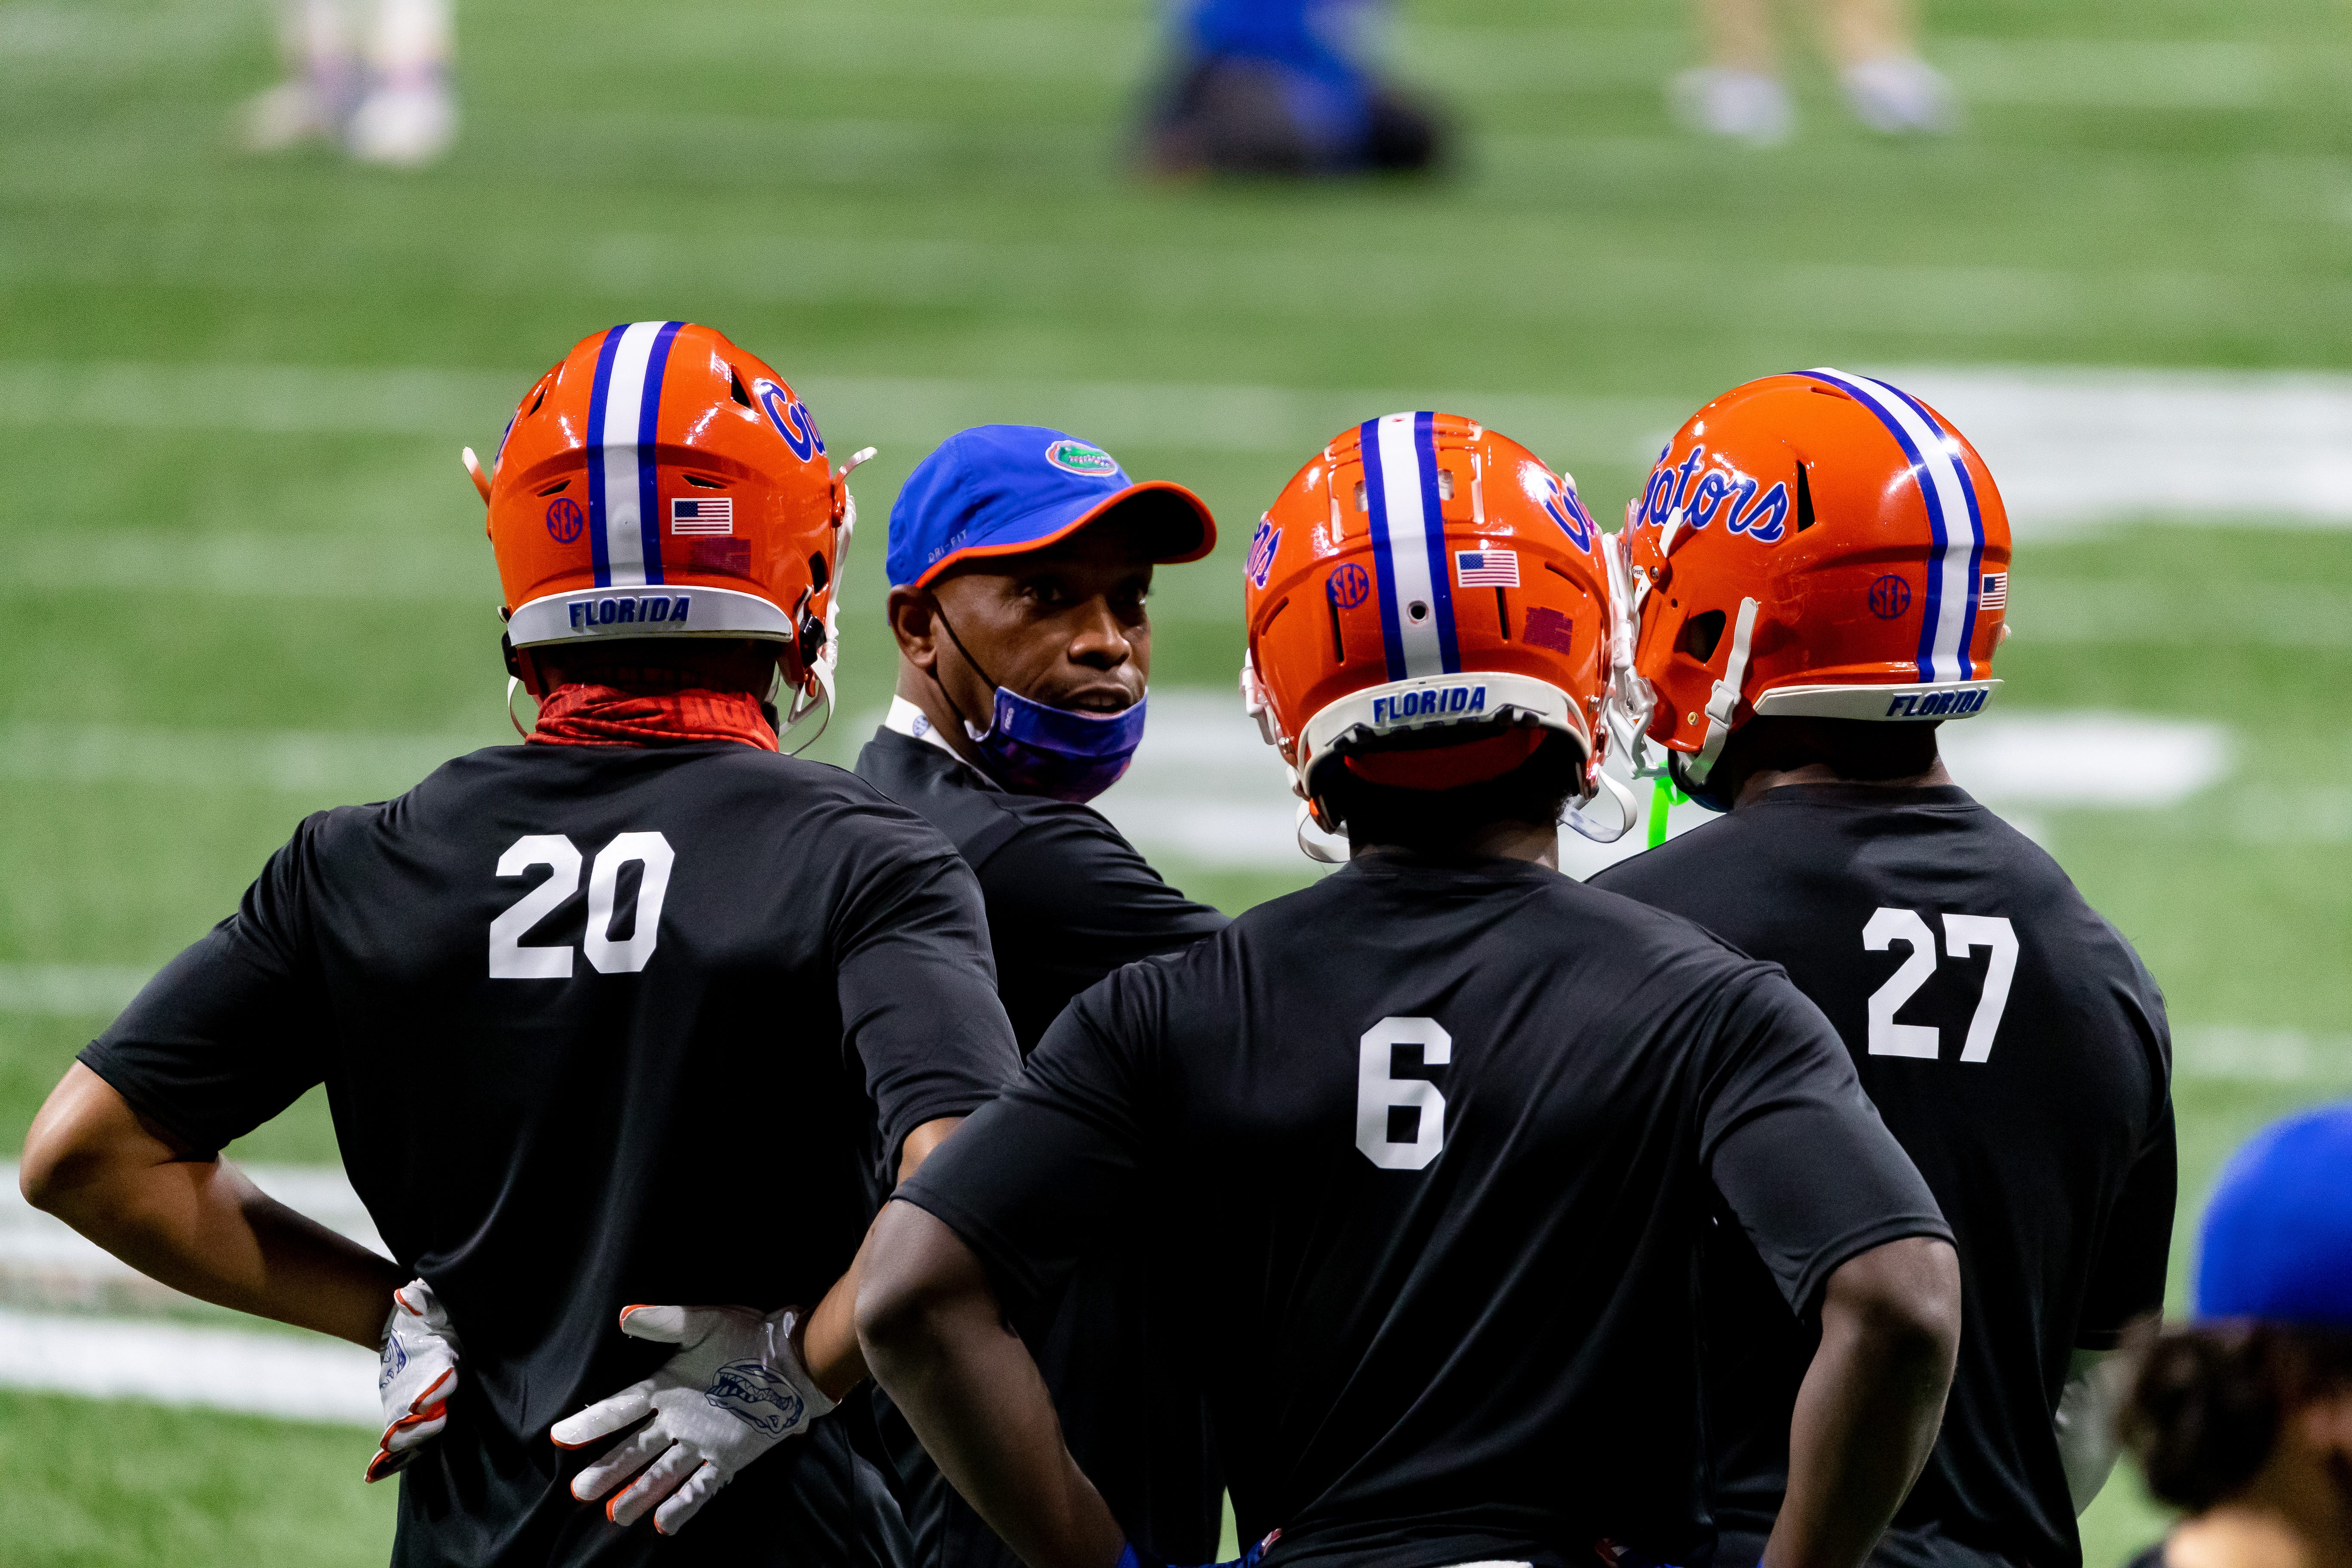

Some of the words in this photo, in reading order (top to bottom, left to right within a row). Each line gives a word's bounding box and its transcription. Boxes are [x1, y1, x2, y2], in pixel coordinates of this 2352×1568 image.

[548, 500, 580, 540] SEC
[1332, 566, 1366, 606] SEC
[1872, 577, 1908, 616] SEC
[567, 596, 691, 628] FLORIDA
[1372, 686, 1486, 723] FLORIDA
[489, 831, 675, 979] 20
[1862, 907, 2019, 1063] 27
[1355, 1016, 1452, 1170] 6
